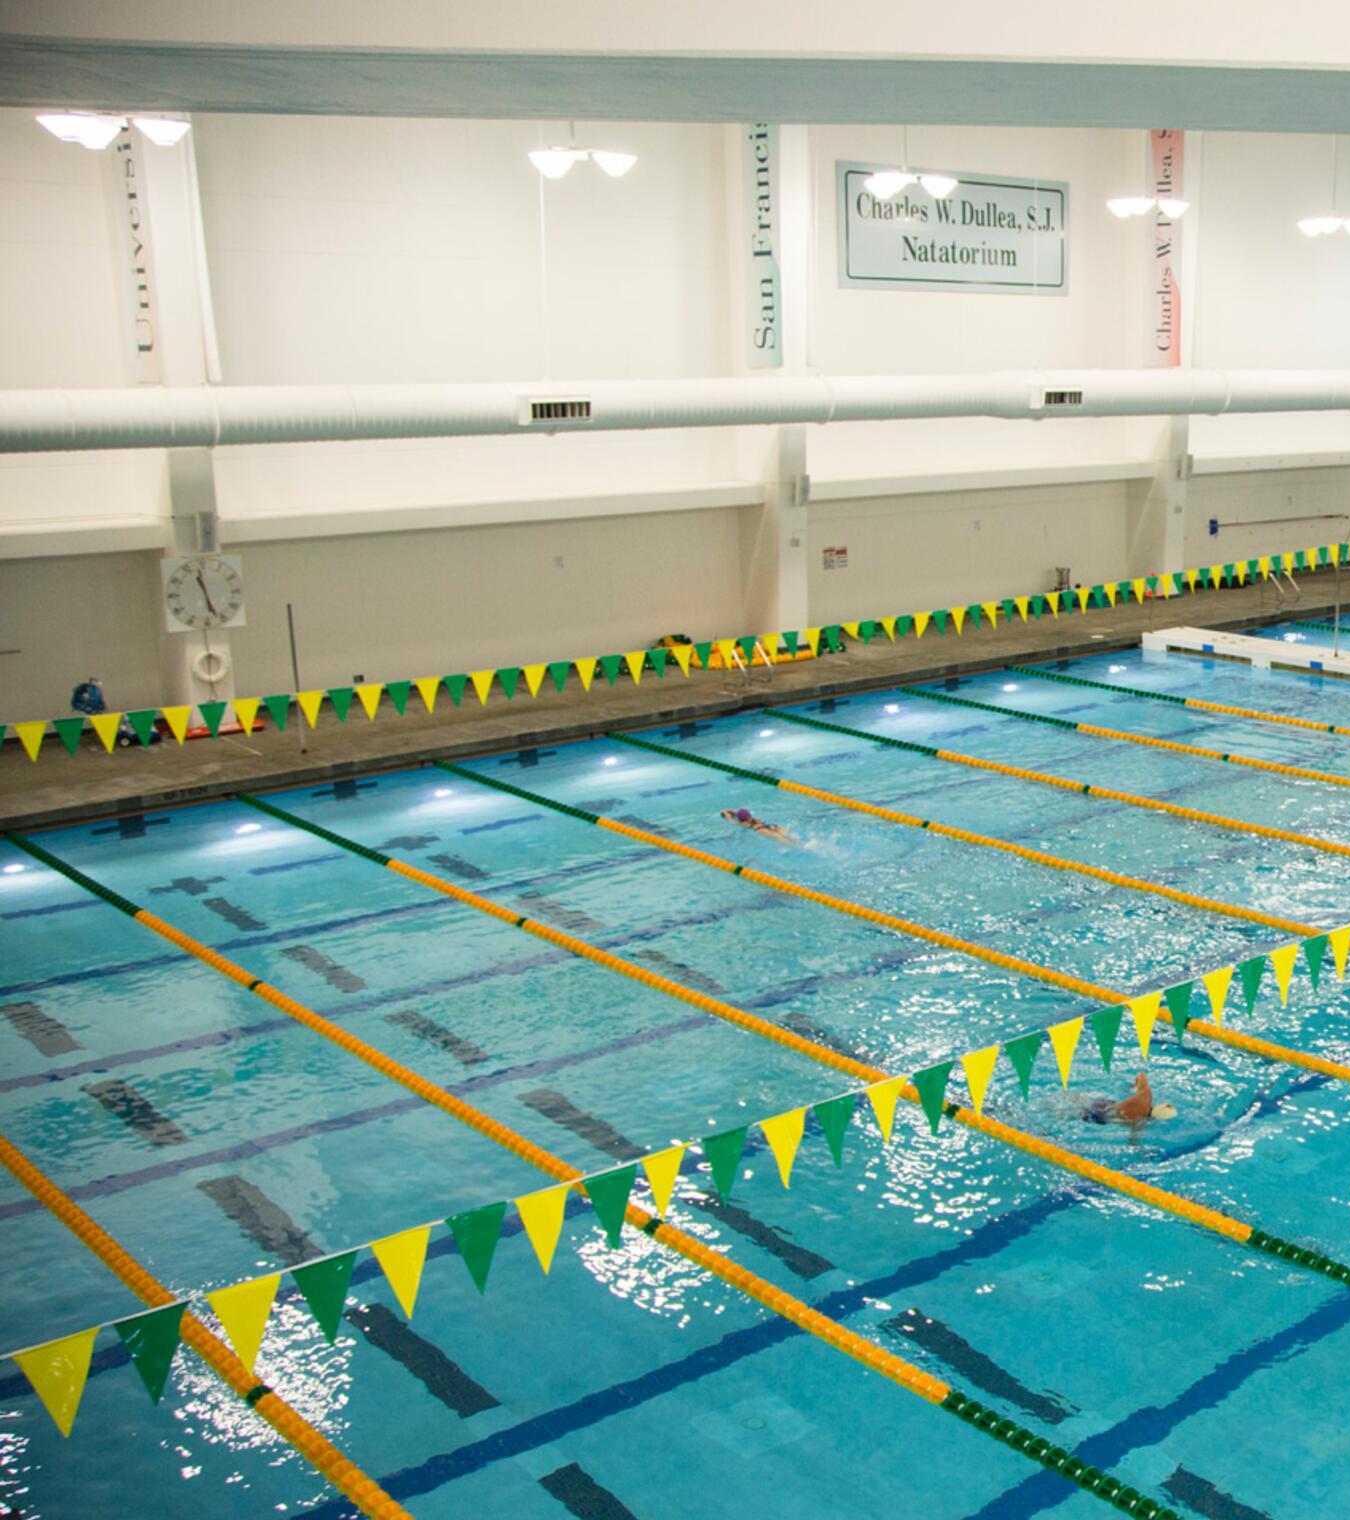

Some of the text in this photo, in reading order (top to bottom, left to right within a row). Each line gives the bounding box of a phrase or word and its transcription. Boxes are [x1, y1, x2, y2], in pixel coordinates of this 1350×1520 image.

[856, 191, 1056, 233] Charles W. Dullea, S.J.
[1156, 147, 1174, 227] Dllea,
[901, 235, 1018, 268] Natatorium
[1156, 238, 1173, 259] W.
[753, 275, 776, 350] San
[1156, 267, 1173, 351] Charles
